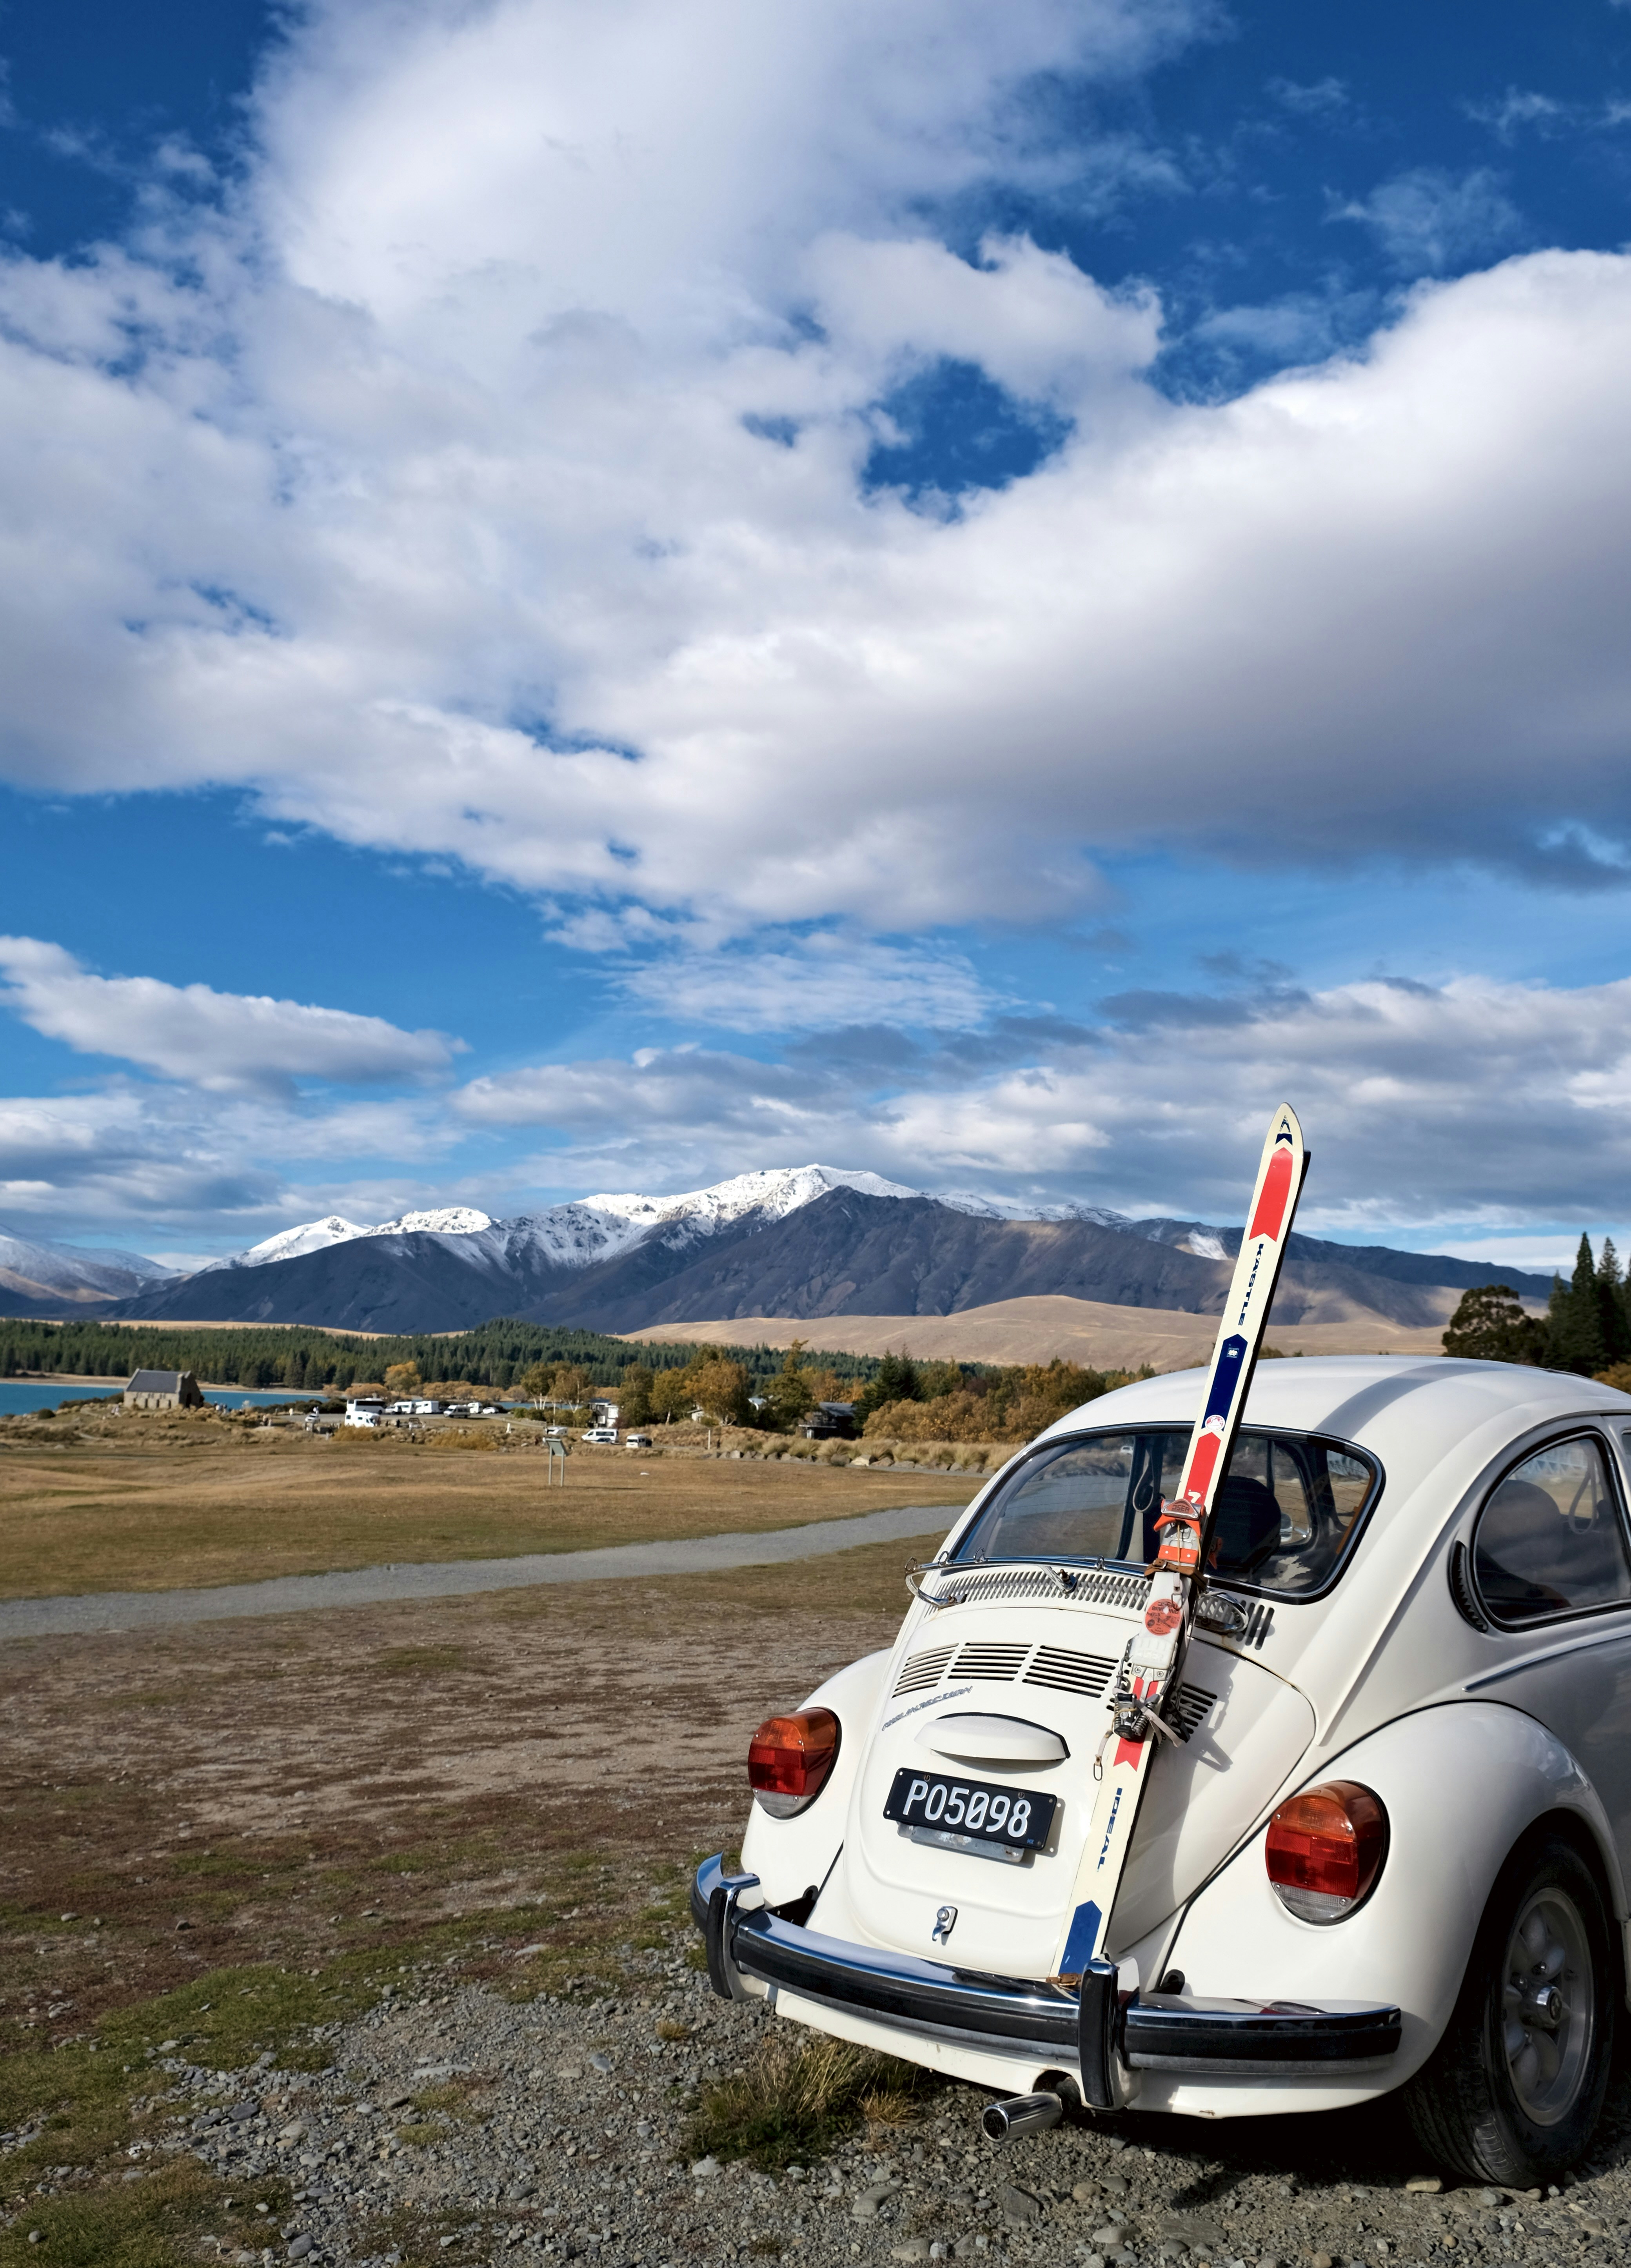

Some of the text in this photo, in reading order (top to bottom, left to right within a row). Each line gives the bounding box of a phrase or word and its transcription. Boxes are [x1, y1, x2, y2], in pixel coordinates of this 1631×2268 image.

[1152, 1606, 1179, 1614] BINING
[902, 1779, 1032, 1838] PO5098
[1097, 1787, 1122, 1872] IDEAL
